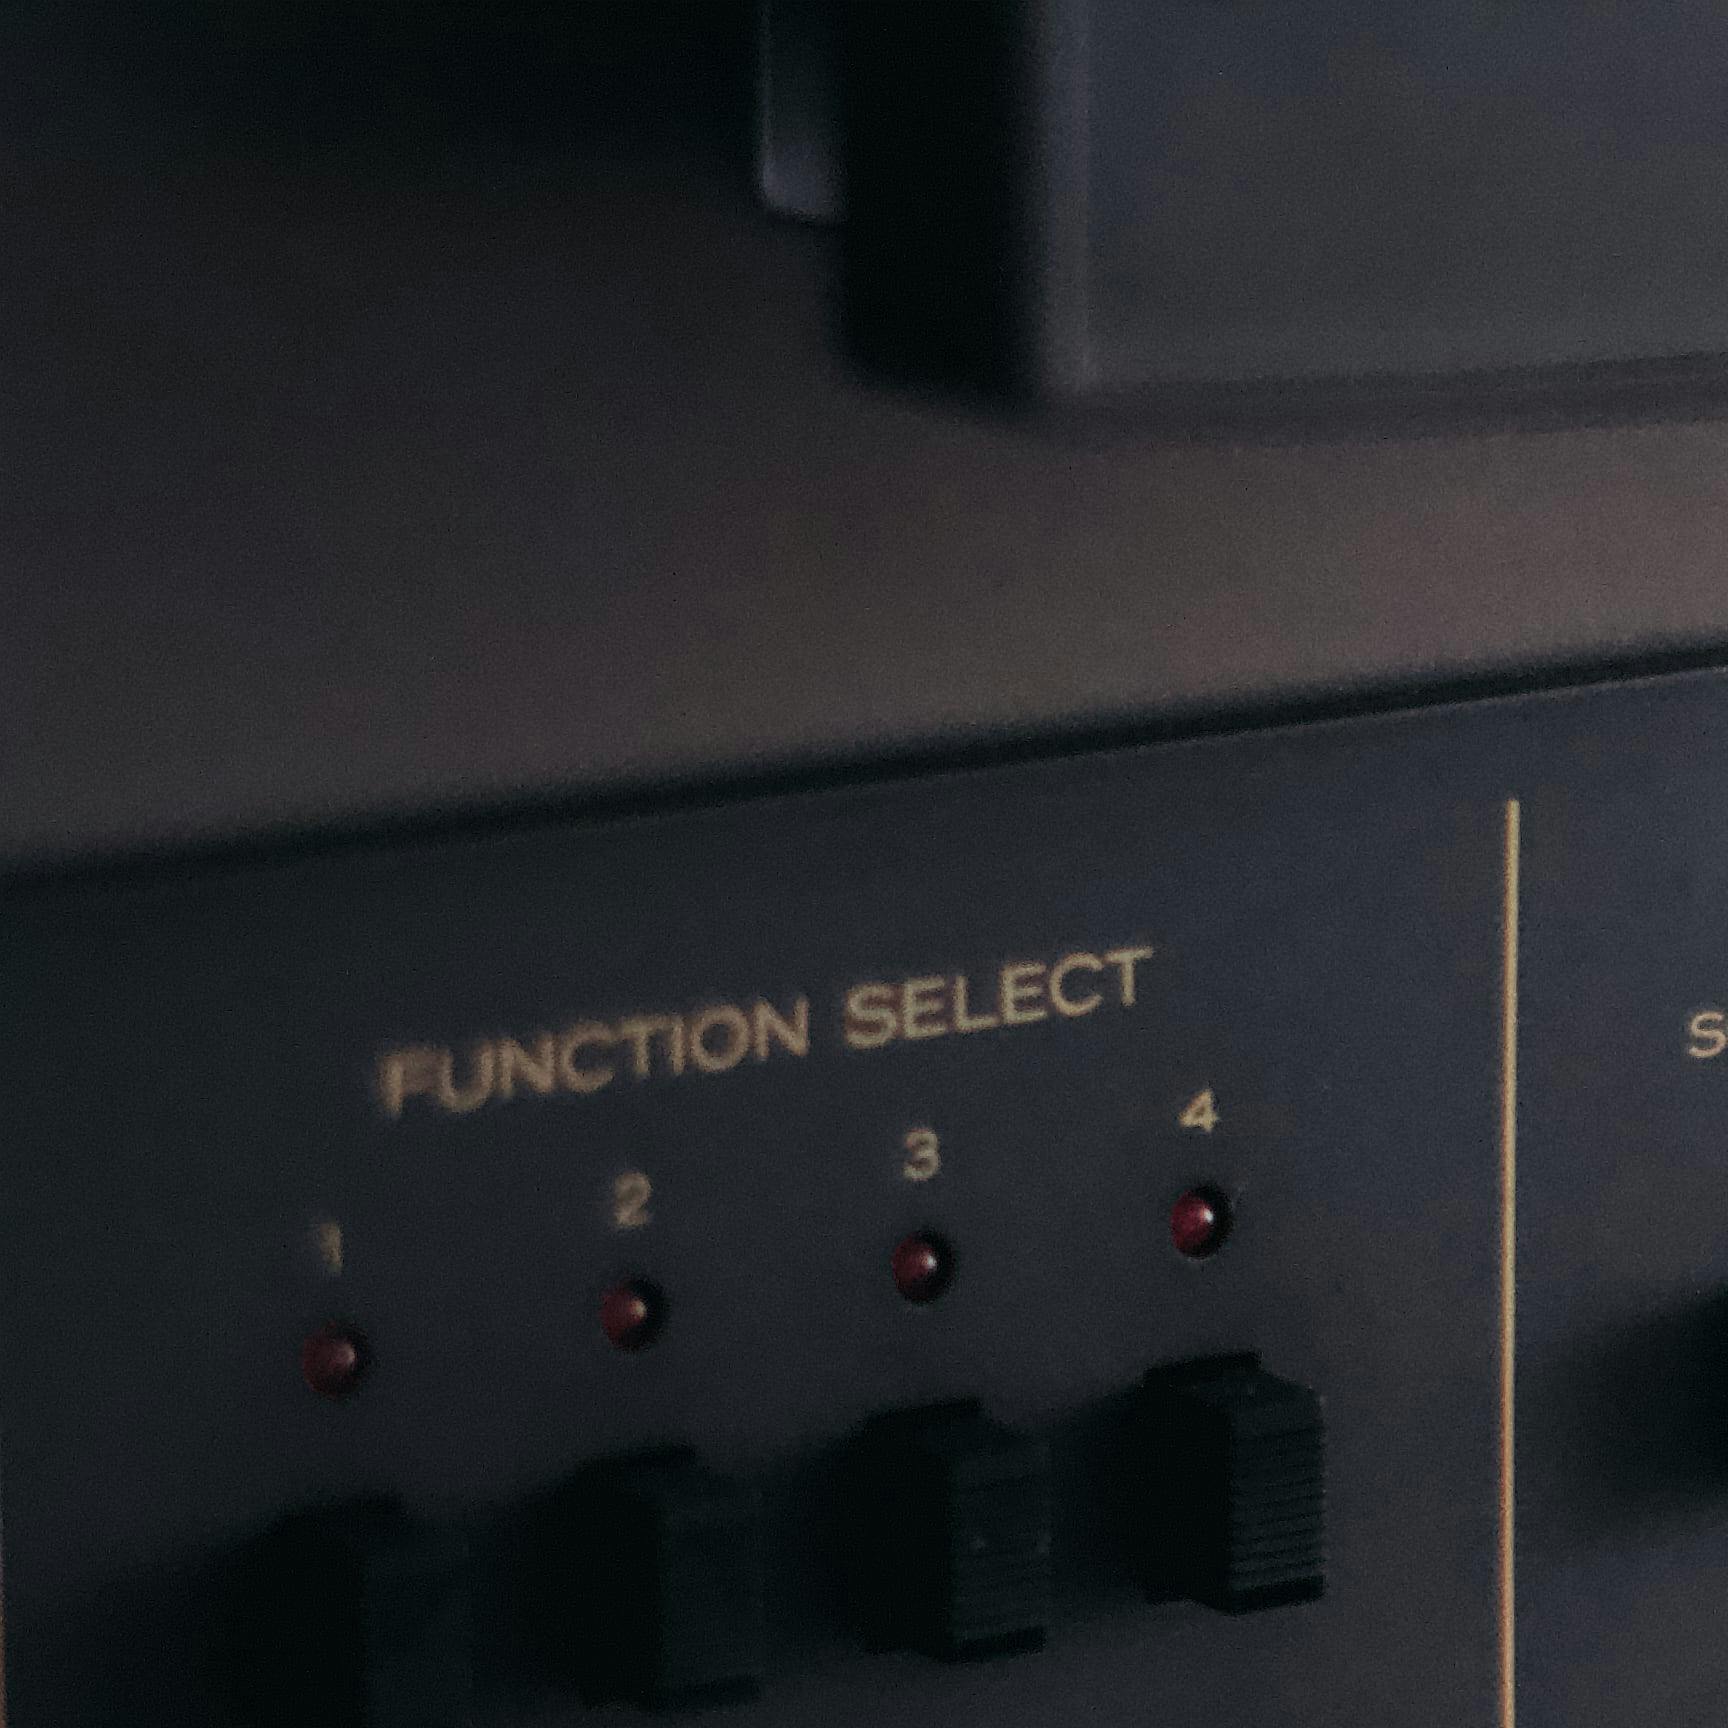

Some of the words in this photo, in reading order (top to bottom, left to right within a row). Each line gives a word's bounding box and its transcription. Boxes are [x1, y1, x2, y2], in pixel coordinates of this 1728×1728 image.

[378, 997, 811, 1114] FUNCTION
[845, 947, 1151, 1048] SELECT
[320, 1224, 342, 1269] 1
[615, 1173, 651, 1227] 2
[904, 1127, 940, 1180] 3
[1179, 1088, 1219, 1133] 4
